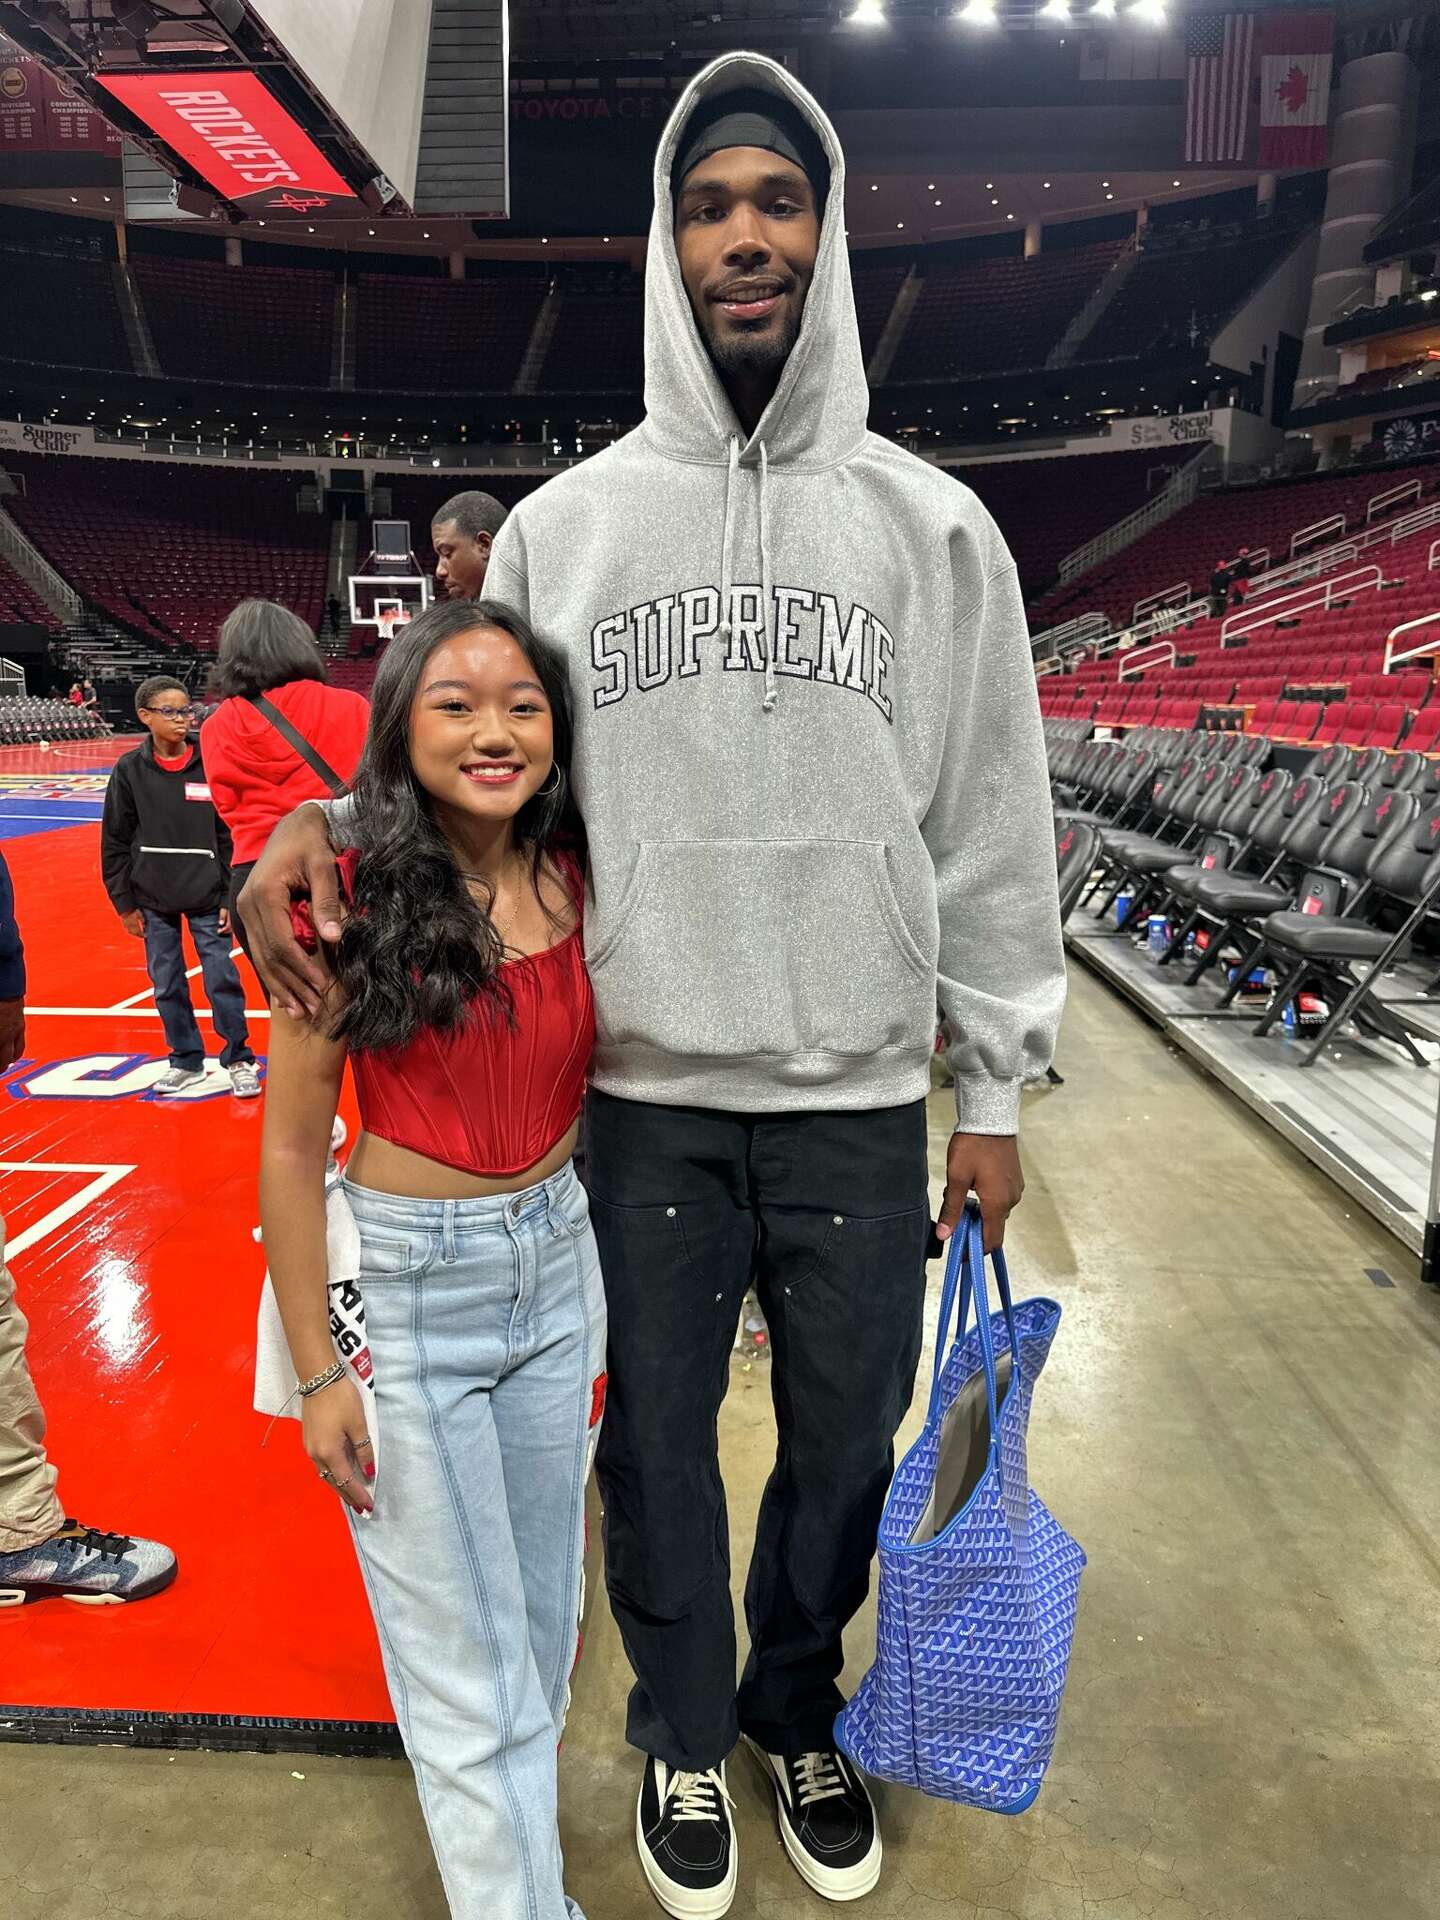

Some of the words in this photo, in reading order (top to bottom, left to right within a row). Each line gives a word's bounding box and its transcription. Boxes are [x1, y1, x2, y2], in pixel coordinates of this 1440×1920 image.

[511, 97, 609, 119] TOYOTA
[158, 90, 301, 183] ROCKETS
[1168, 411, 1214, 434] Social
[1174, 425, 1209, 441] Club
[22, 425, 82, 445] Supper
[33, 438, 71, 452] Club
[590, 583, 895, 726] SUPREME
